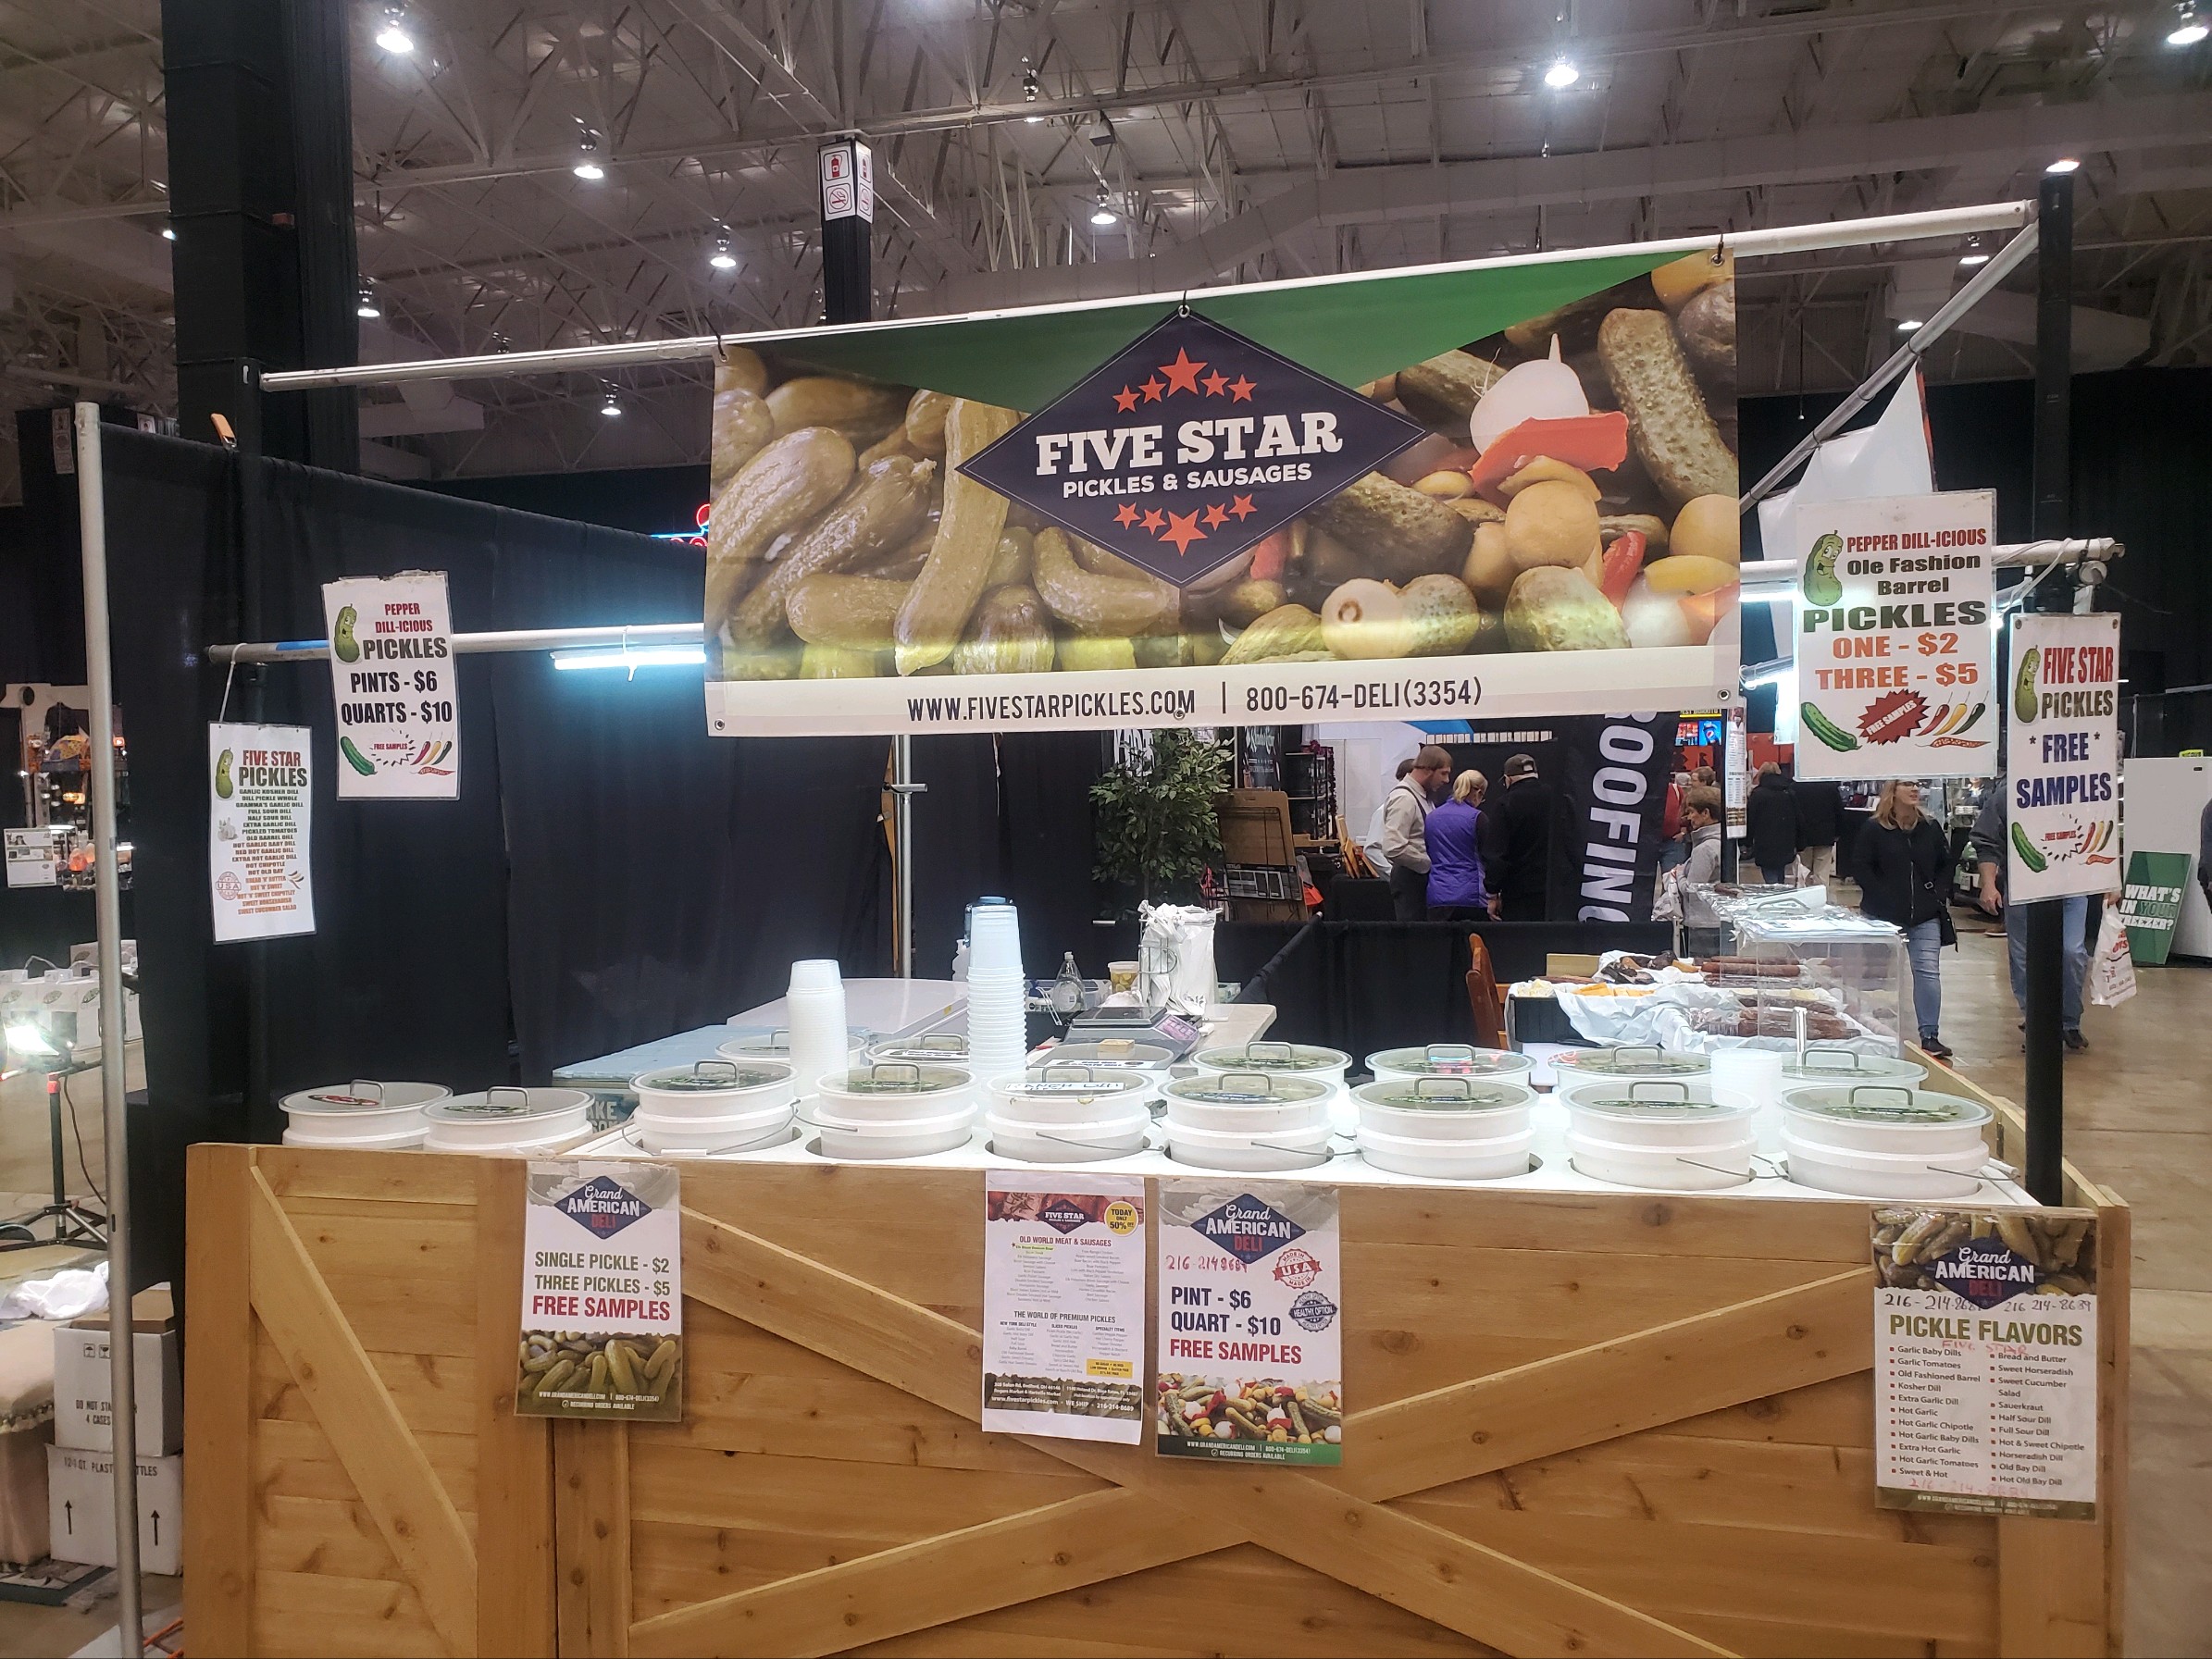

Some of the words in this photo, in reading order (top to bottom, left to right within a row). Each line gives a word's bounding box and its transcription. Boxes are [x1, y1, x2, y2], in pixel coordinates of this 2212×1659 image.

[1037, 425, 1163, 476] FIVE
[1177, 412, 1343, 464] STAR
[1063, 476, 1155, 499] PICKLES
[1162, 474, 1178, 491] &
[1187, 464, 1312, 489] SAUSAGES
[1846, 534, 1897, 553] PEPPER
[1902, 528, 1987, 551] DILL-ICIOUS
[1847, 560, 1883, 576] Ole
[1890, 554, 1981, 574] Fashion
[1878, 577, 1949, 596] Barrel
[384, 603, 421, 616] PEPPER
[1803, 600, 1986, 633] PICKLES
[376, 620, 433, 633] DILL-ICIOUS
[363, 638, 448, 660] PICKLES
[1833, 636, 1891, 659] ONE
[1918, 632, 1958, 657] $2
[2044, 648, 2075, 685] FIVE
[2078, 647, 2113, 684] STAR
[351, 672, 400, 693] PINTS
[414, 670, 438, 693] $6
[1815, 666, 1908, 690] THREE
[1935, 662, 1978, 687] $5
[907, 689, 1195, 722] WWW.FIVESTARPICKLES.COM
[1247, 676, 1482, 712] 800-674-DELI(3354)
[2042, 690, 2113, 720] PICKLES
[341, 703, 407, 726] QUARTS
[421, 700, 453, 724] $10
[1867, 718, 1884, 736] FREE
[1883, 700, 1918, 726] SAMPLES
[2043, 732, 2089, 763] FREE
[242, 750, 268, 767] FIVE
[270, 750, 302, 767] STAR
[239, 767, 308, 787] PICKLES
[2017, 773, 2112, 809] SAMPLES
[1578, 712, 1658, 922] OOFIN
[2045, 832, 2056, 842] FREE
[2057, 830, 2077, 840] SAMPLES
[2125, 885, 2182, 903] WHAT'S
[2119, 899, 2138, 914] IN
[2140, 901, 2177, 919] YOUR
[584, 1185, 624, 1203] Grand
[566, 1197, 640, 1217] AMERICAN
[1045, 1211, 1063, 1219] FIVE
[1063, 1212, 1085, 1220] STAR
[1225, 1205, 1272, 1221] Grand
[591, 1214, 617, 1229] DELI
[1110, 1221, 1127, 1230] 50%
[1206, 1218, 1291, 1240] AMERICAN
[1020, 1235, 1031, 1244] OLD
[1033, 1236, 1054, 1244] WORLD
[1080, 1239, 1112, 1247] SAUSAGES
[1235, 1234, 1263, 1252] DELI
[535, 1252, 585, 1269] SINGLE
[590, 1254, 639, 1271] PICKLE
[652, 1257, 670, 1274] $2
[1283, 1252, 1297, 1262] MADE
[1958, 1246, 2012, 1266] Grand
[1281, 1262, 1312, 1276] USA
[1935, 1260, 2034, 1284] AMERICAN
[535, 1275, 579, 1291] THREE
[583, 1276, 640, 1294] PICKLES
[653, 1280, 671, 1296] $5
[1171, 1286, 1212, 1306] PINT
[1229, 1289, 1251, 1310] $6
[2004, 1302, 2026, 1312] 216
[532, 1295, 578, 1317] FREE
[584, 1297, 671, 1321] SAMPLES
[1294, 1307, 1314, 1318] HEALTHY
[1314, 1306, 1333, 1316] OPTION
[1027, 1311, 1049, 1319] WORLD
[1050, 1312, 1058, 1320] OF
[1060, 1313, 1089, 1322] PREMIUM
[1090, 1314, 1116, 1324] PICKLES
[1171, 1311, 1230, 1333] QUART
[1248, 1316, 1281, 1337] $10
[1890, 1315, 1970, 1341] PICKLE
[1979, 1320, 2082, 1346] FLAVORS
[1170, 1339, 1213, 1359] FREE
[1219, 1342, 1302, 1365] SAMPLES
[1897, 1345, 1920, 1355] Garlic
[1922, 1347, 1943, 1356] Baby
[1944, 1349, 1962, 1357] Dills
[1998, 1353, 2022, 1361] Bread
[2041, 1355, 2068, 1363] Butter
[1897, 1357, 1921, 1367] Garlic
[1922, 1359, 1961, 1369] Tomatoes
[1998, 1365, 2023, 1373] Sweet
[2025, 1367, 2074, 1376] Horseradish
[1898, 1369, 1912, 1378] Old
[1914, 1371, 1956, 1380] Fashioned
[1957, 1374, 1981, 1382] Barrel
[1998, 1377, 2024, 1386] Sweet
[2025, 1379, 2068, 1388] Cucumber
[1898, 1382, 1926, 1391] Kosher
[1928, 1384, 1942, 1393] Dill
[1998, 1389, 2021, 1398] Salad
[991, 1395, 1059, 1405] www.fivestarpickles.com
[1898, 1394, 1920, 1403] Extra
[1920, 1396, 1944, 1405] Garlic
[1998, 1402, 2044, 1412] Sauerkraut
[93, 1415, 111, 1426] CASES
[1898, 1406, 1914, 1415] Hot
[1915, 1408, 1939, 1417] Garlic
[1898, 1418, 1914, 1427] Hot
[1915, 1420, 1939, 1429] Garlic
[1940, 1422, 1974, 1431] Chipotle
[1899, 1430, 1914, 1439] Hot
[1915, 1432, 1939, 1441] Garlic
[1940, 1434, 1960, 1443] Baby
[1899, 1443, 1920, 1452] Extra
[1921, 1444, 1936, 1454] Hot
[1938, 1446, 1961, 1455] Garlic
[92, 1462, 114, 1474] PLAST
[1899, 1455, 1915, 1464] Hot
[1916, 1456, 1939, 1466] Garlic
[1940, 1458, 1979, 1468] Tomatoes
[1899, 1467, 1924, 1476] Sweet
